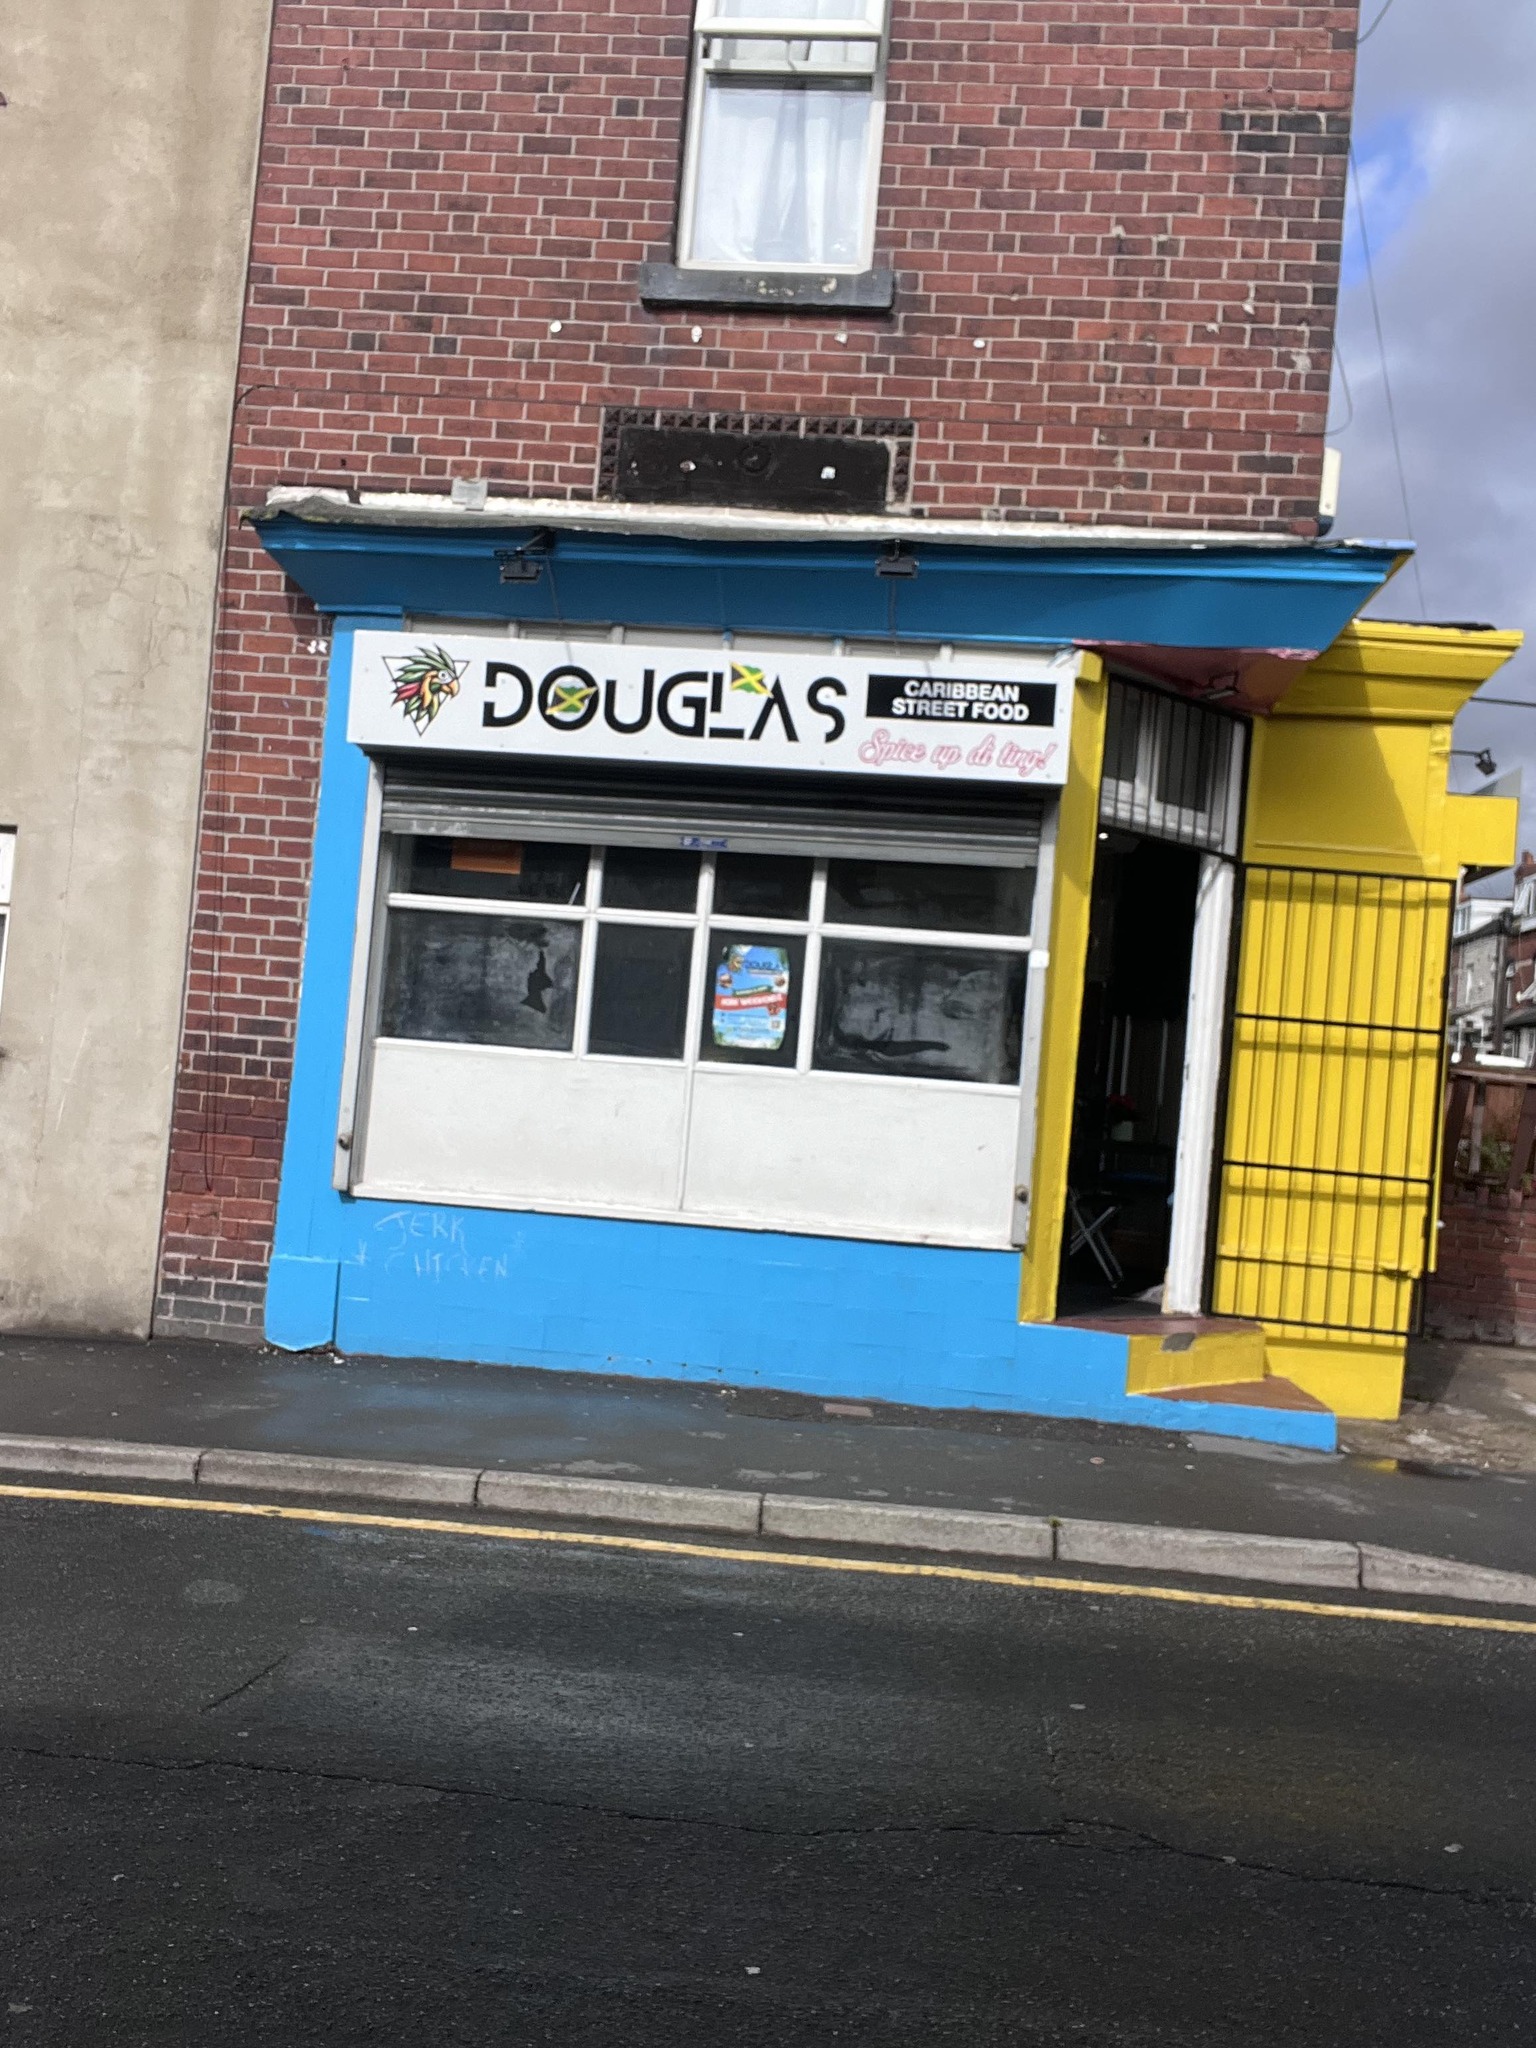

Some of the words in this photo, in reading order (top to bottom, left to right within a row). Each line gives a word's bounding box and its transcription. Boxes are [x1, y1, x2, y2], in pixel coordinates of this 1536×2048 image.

[482, 661, 848, 744] DOUGLAS
[892, 697, 969, 718] STREET
[971, 703, 1030, 722] FOOD
[904, 680, 1020, 702] CARIBBEAN
[859, 728, 927, 766] Spice
[930, 744, 961, 770] up
[966, 733, 996, 767] di
[997, 740, 1058, 777] ting!
[374, 1210, 466, 1252] JERK
